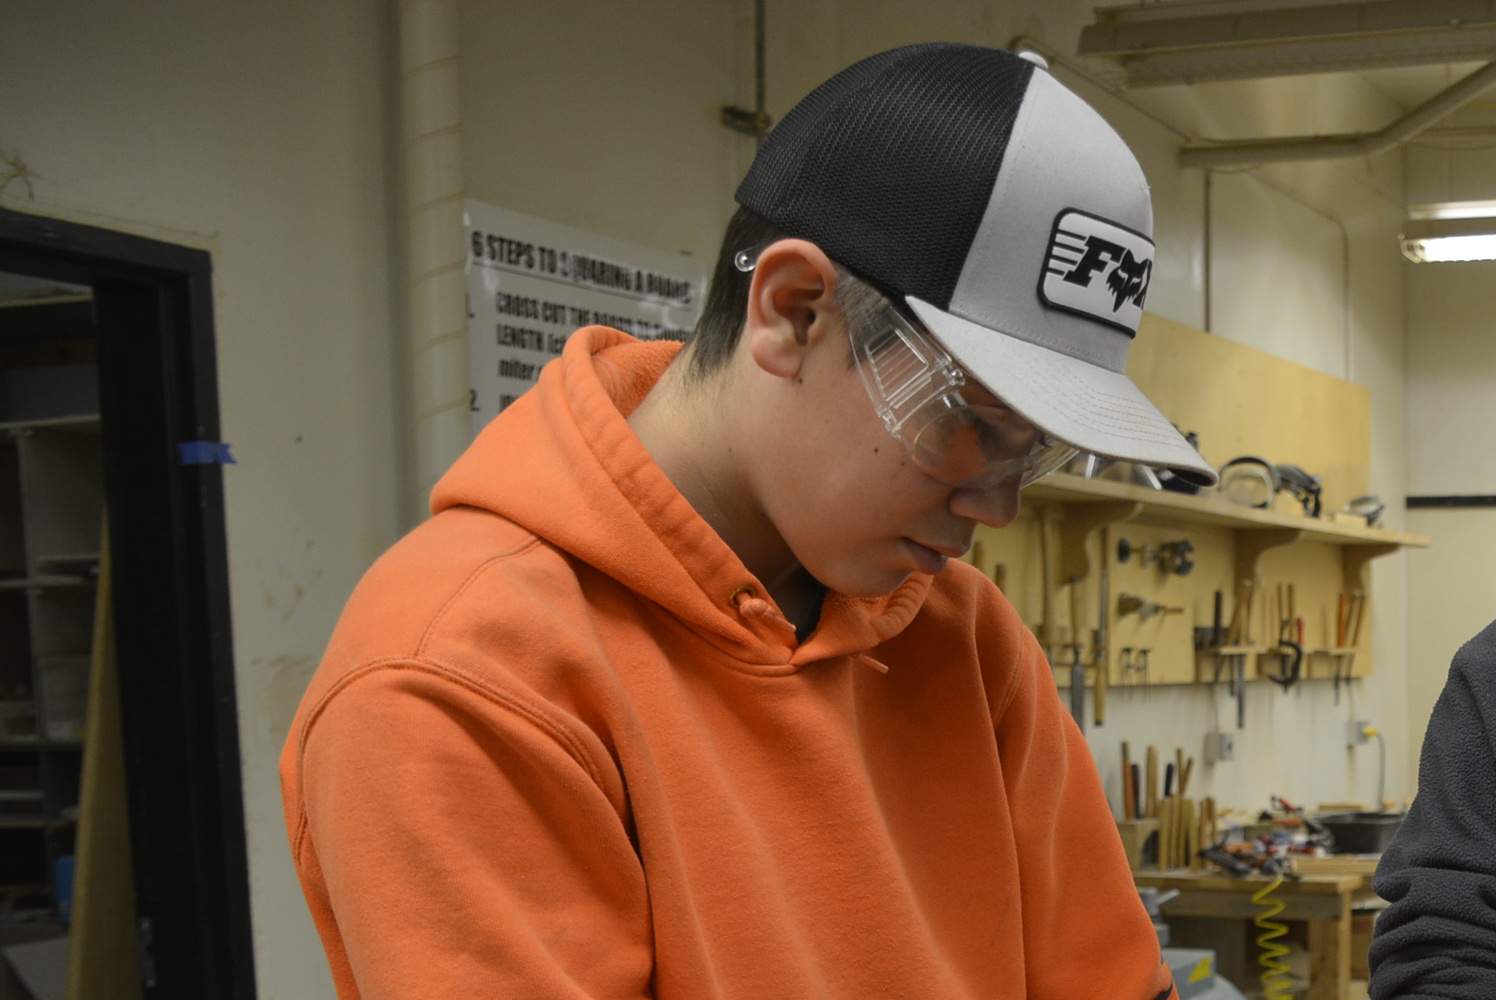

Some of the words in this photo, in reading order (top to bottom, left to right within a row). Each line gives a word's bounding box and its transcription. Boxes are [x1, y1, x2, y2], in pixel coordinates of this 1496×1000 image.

[472, 231, 483, 257] 6
[486, 234, 534, 269] STEPS
[538, 247, 557, 273] TO
[635, 271, 644, 292] A
